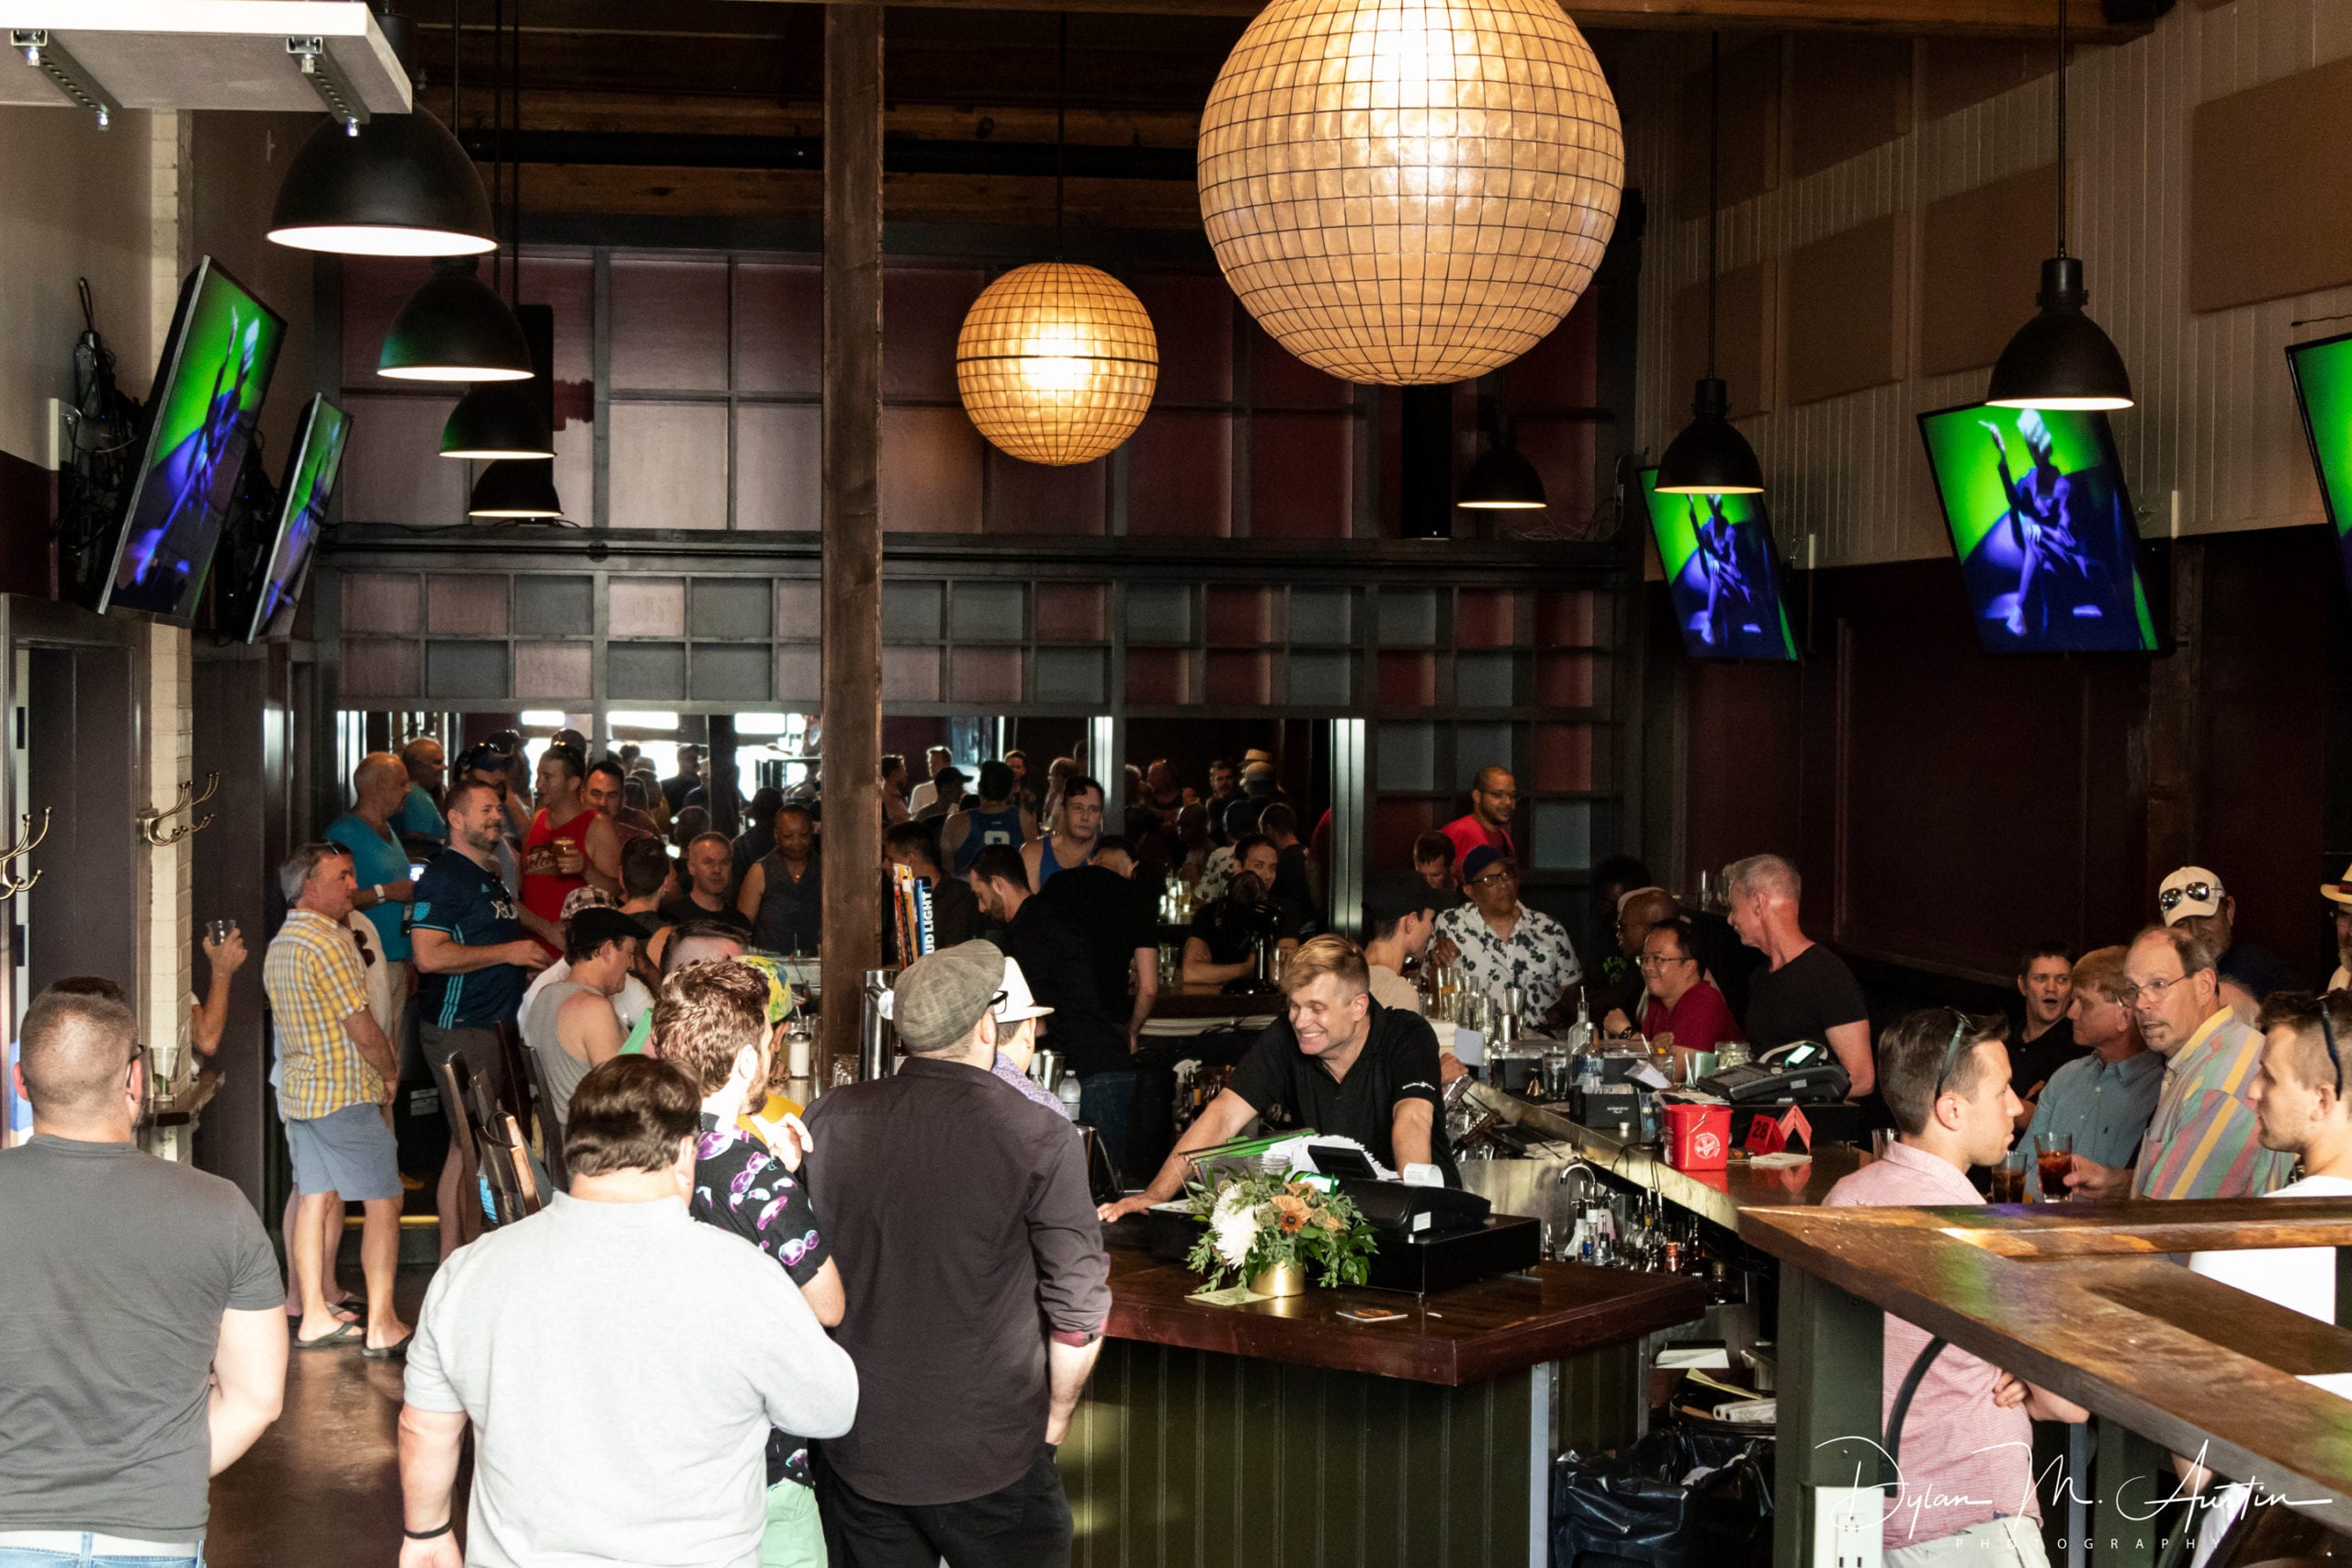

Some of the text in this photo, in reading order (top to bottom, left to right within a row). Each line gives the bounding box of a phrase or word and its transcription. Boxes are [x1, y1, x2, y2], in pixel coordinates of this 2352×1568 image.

[491, 900, 518, 919] XBO
[922, 891, 935, 954] UD LIGHT
[1752, 1121, 1770, 1140] 28
